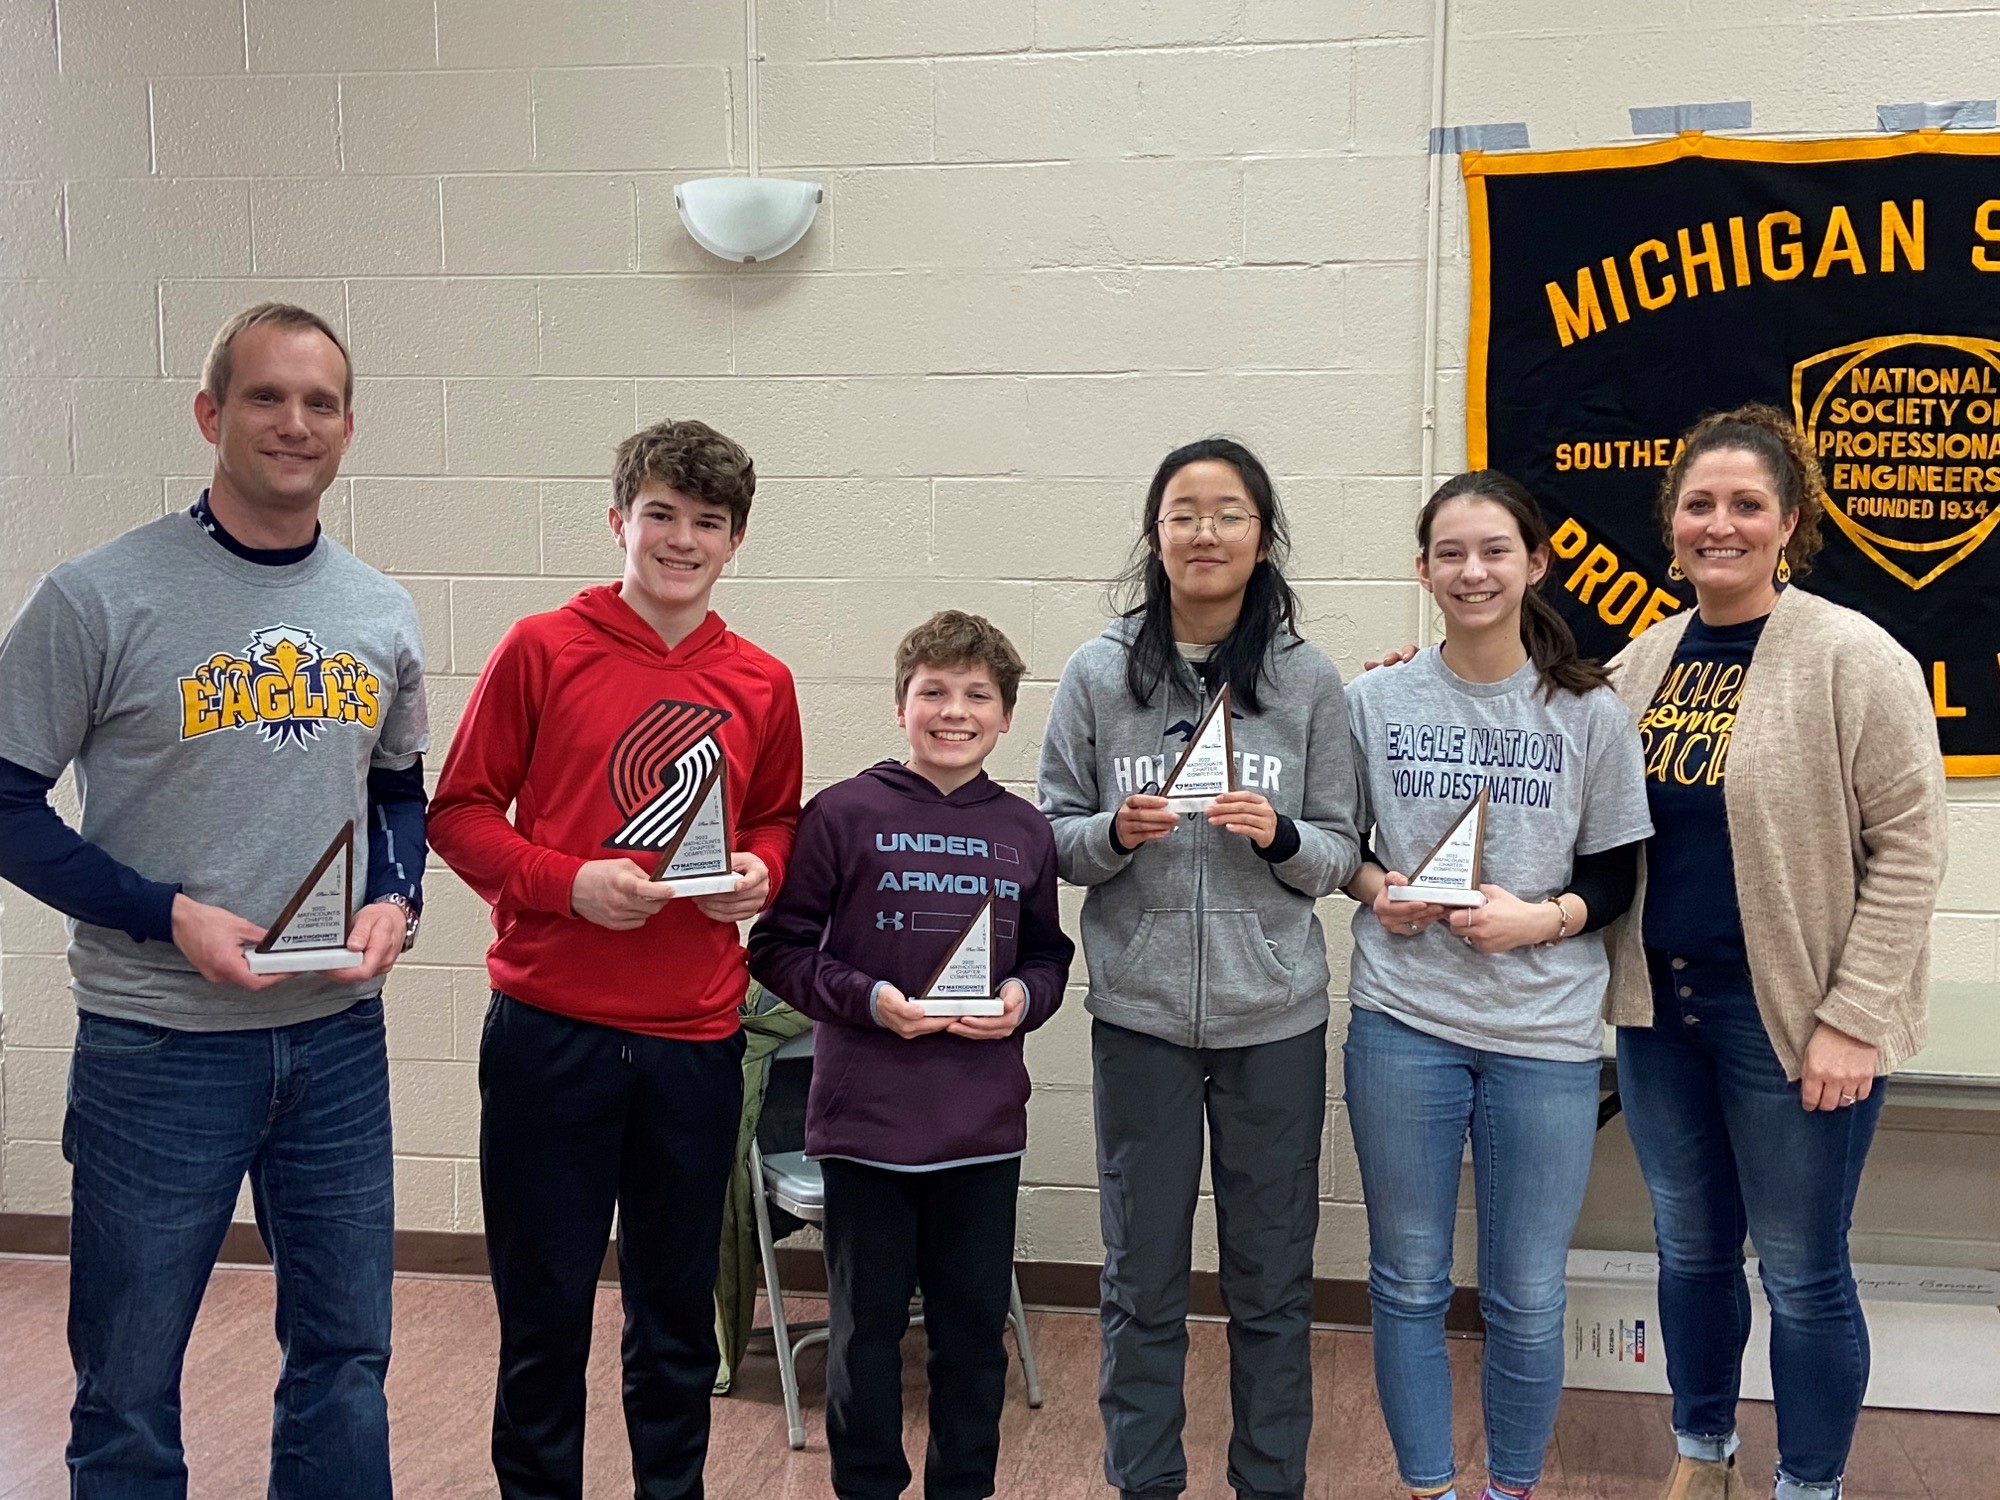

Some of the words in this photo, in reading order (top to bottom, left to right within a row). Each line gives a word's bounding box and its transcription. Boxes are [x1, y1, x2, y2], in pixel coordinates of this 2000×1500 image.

[1545, 198, 1925, 347] MICHIGAN
[1851, 366, 1997, 395] NATIONAL
[1829, 398, 1961, 427] SOCIETY
[1833, 463, 2000, 493] ENGINEERS
[1846, 496, 1934, 519] FOUNDED
[1940, 500, 1989, 520] 1934
[180, 673, 380, 741] EAGLES
[1385, 723, 1465, 763] EAGLE
[1469, 728, 1563, 773] NATION
[1392, 769, 1434, 798] YOUR
[875, 833, 989, 858] UNDER
[681, 860, 721, 868] MATHCOUNTS
[876, 871, 1021, 901] ARMOUR
